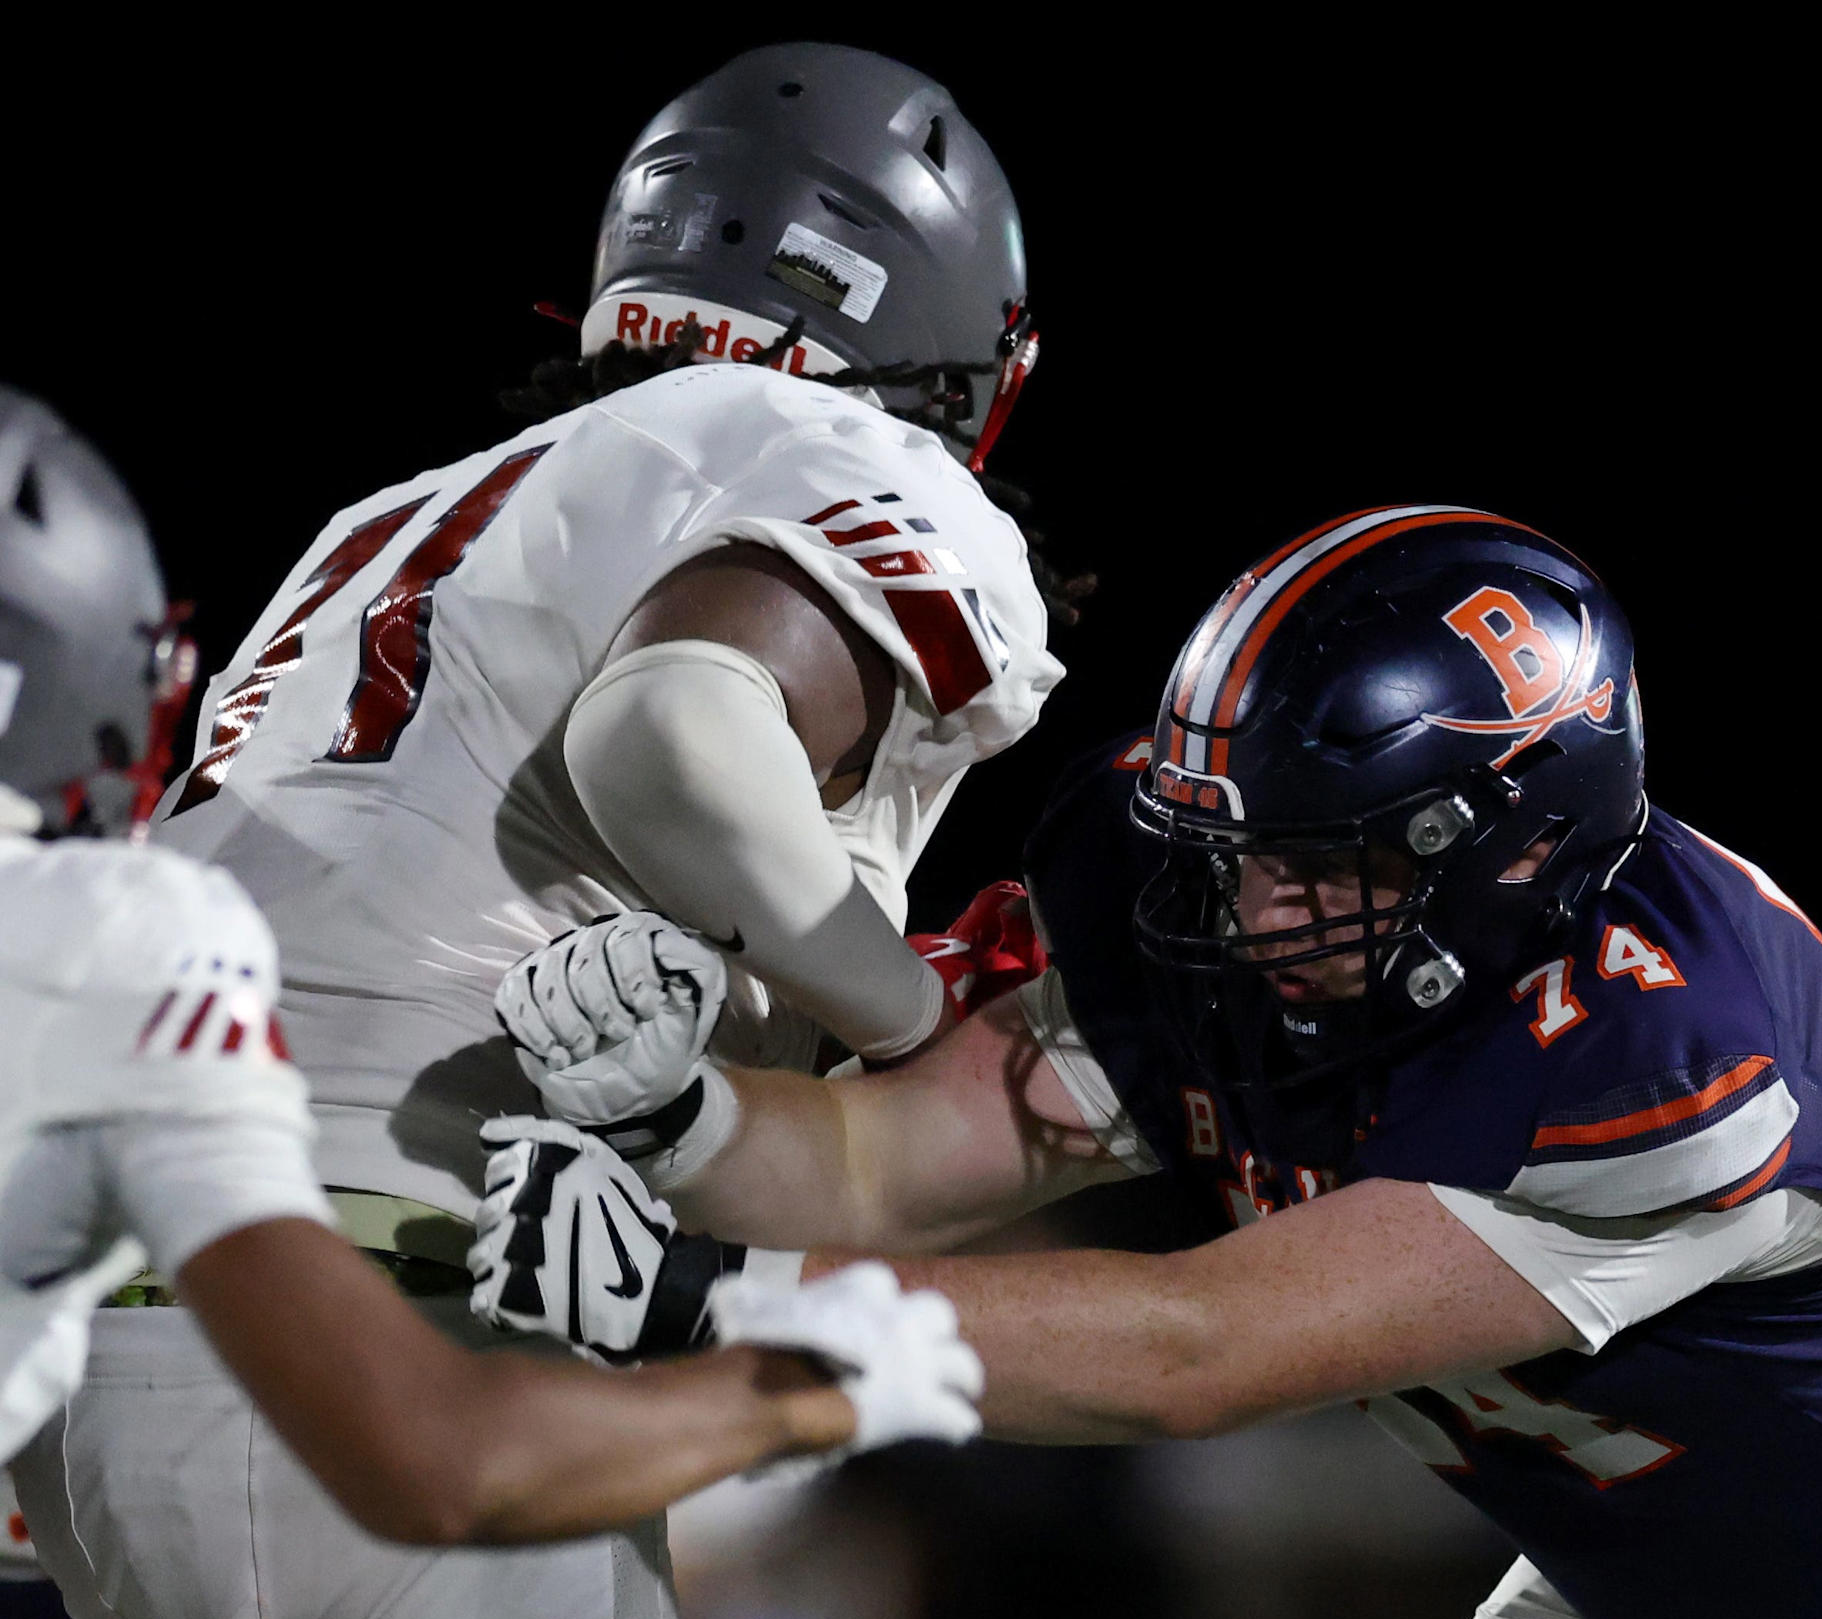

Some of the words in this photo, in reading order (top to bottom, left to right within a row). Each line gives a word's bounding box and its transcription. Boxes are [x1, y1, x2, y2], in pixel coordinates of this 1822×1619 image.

[1441, 585, 1564, 719] B
[1160, 773, 1192, 804] TEAM
[1509, 923, 1687, 1049] 74
